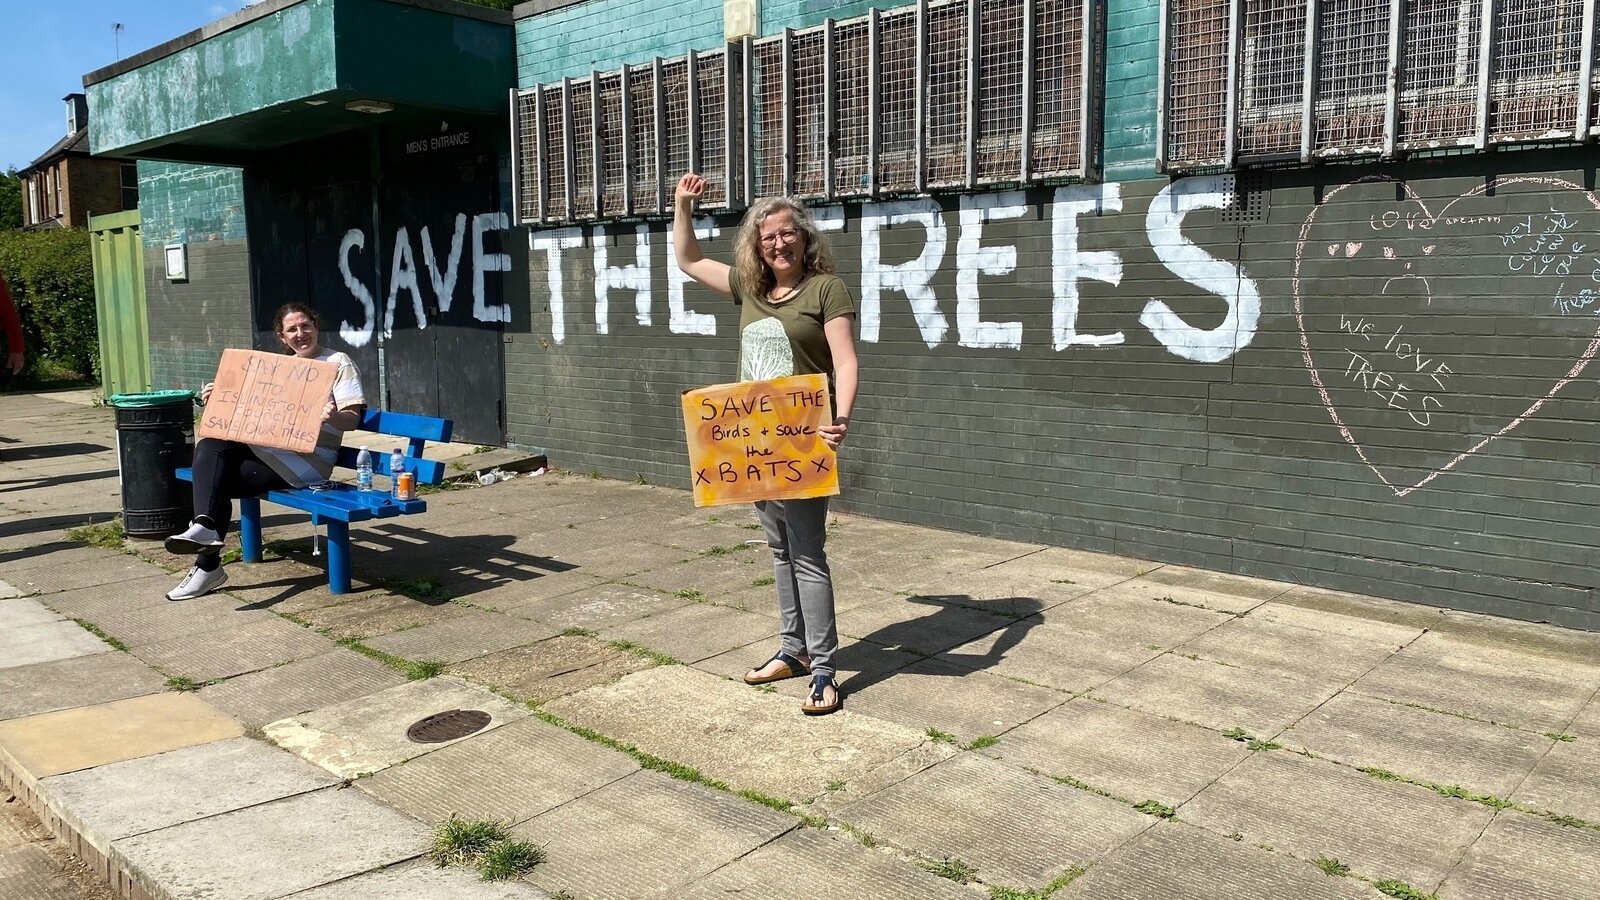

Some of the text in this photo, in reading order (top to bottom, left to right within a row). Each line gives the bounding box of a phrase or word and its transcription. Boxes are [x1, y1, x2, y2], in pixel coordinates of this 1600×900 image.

[406, 132, 470, 154] MEN'S ENTRANCE
[338, 175, 1262, 363] SAVE THE REES
[286, 364, 319, 382] NO
[258, 382, 282, 396] TO
[1344, 347, 1443, 426] TREES
[218, 390, 309, 414] ISLINGTON
[701, 389, 825, 421] SAVE THE
[245, 421, 278, 438] OUR
[712, 424, 751, 441] Birds
[746, 445, 774, 457] the
[719, 460, 803, 483] BATS
